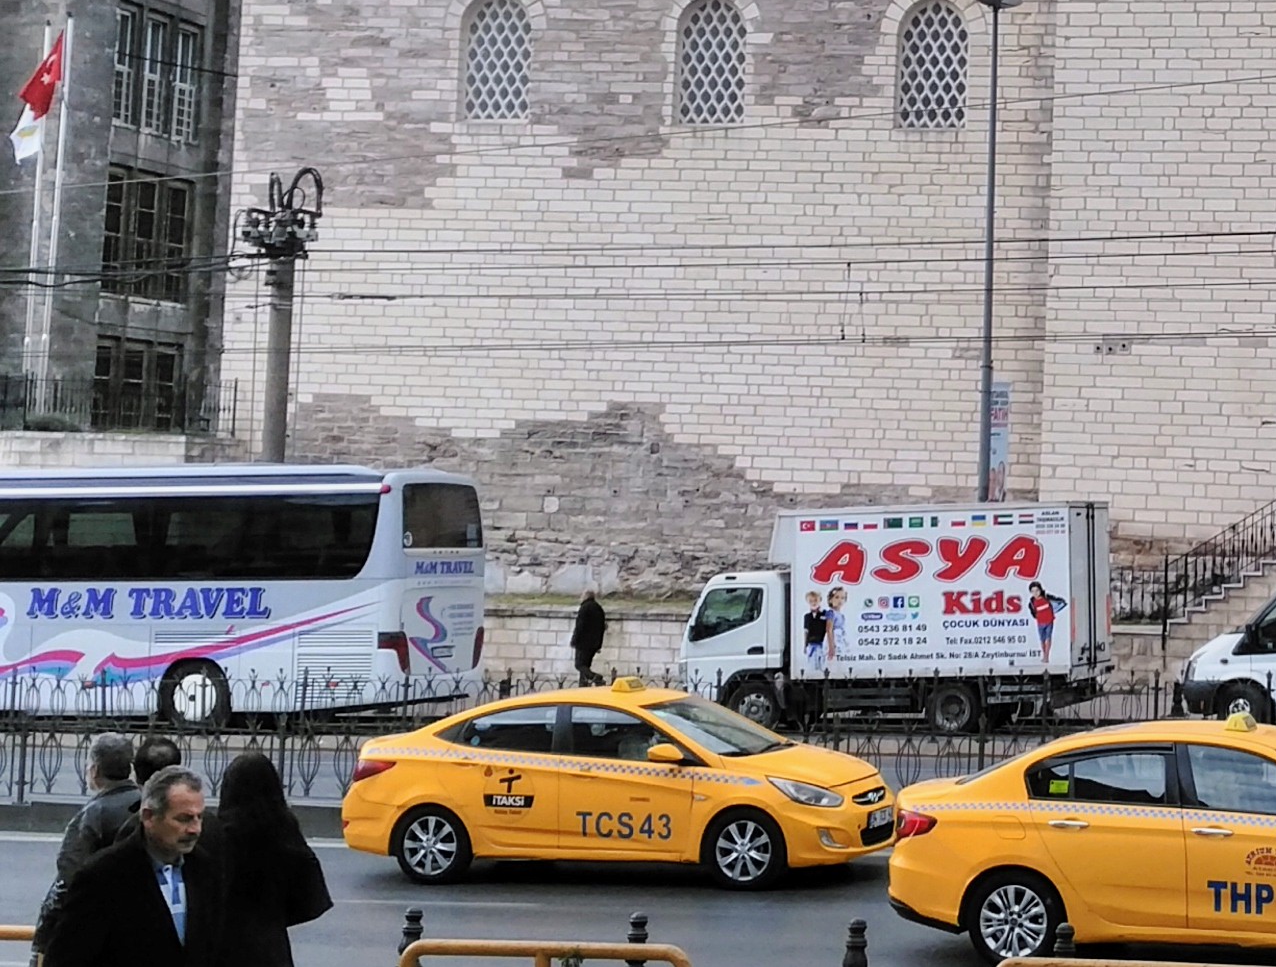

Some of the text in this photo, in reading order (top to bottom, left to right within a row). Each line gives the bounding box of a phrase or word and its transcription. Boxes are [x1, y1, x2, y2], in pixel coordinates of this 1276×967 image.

[810, 534, 1044, 585] ASYA
[415, 561, 475, 575] M&M TRAVEL
[26, 587, 272, 619] M&M TRAVEL
[942, 590, 1022, 615] Kids
[857, 623, 927, 634] 0543 236 81 49
[942, 618, 1029, 631] ÇOCUK DÜNYASI
[857, 636, 927, 646] 0542 572 18 24
[993, 636, 1006, 644] 546
[1007, 636, 1016, 644] 95
[1017, 635, 1027, 643] 03
[836, 654, 857, 662] Telsiz
[1207, 880, 1274, 914] THP
